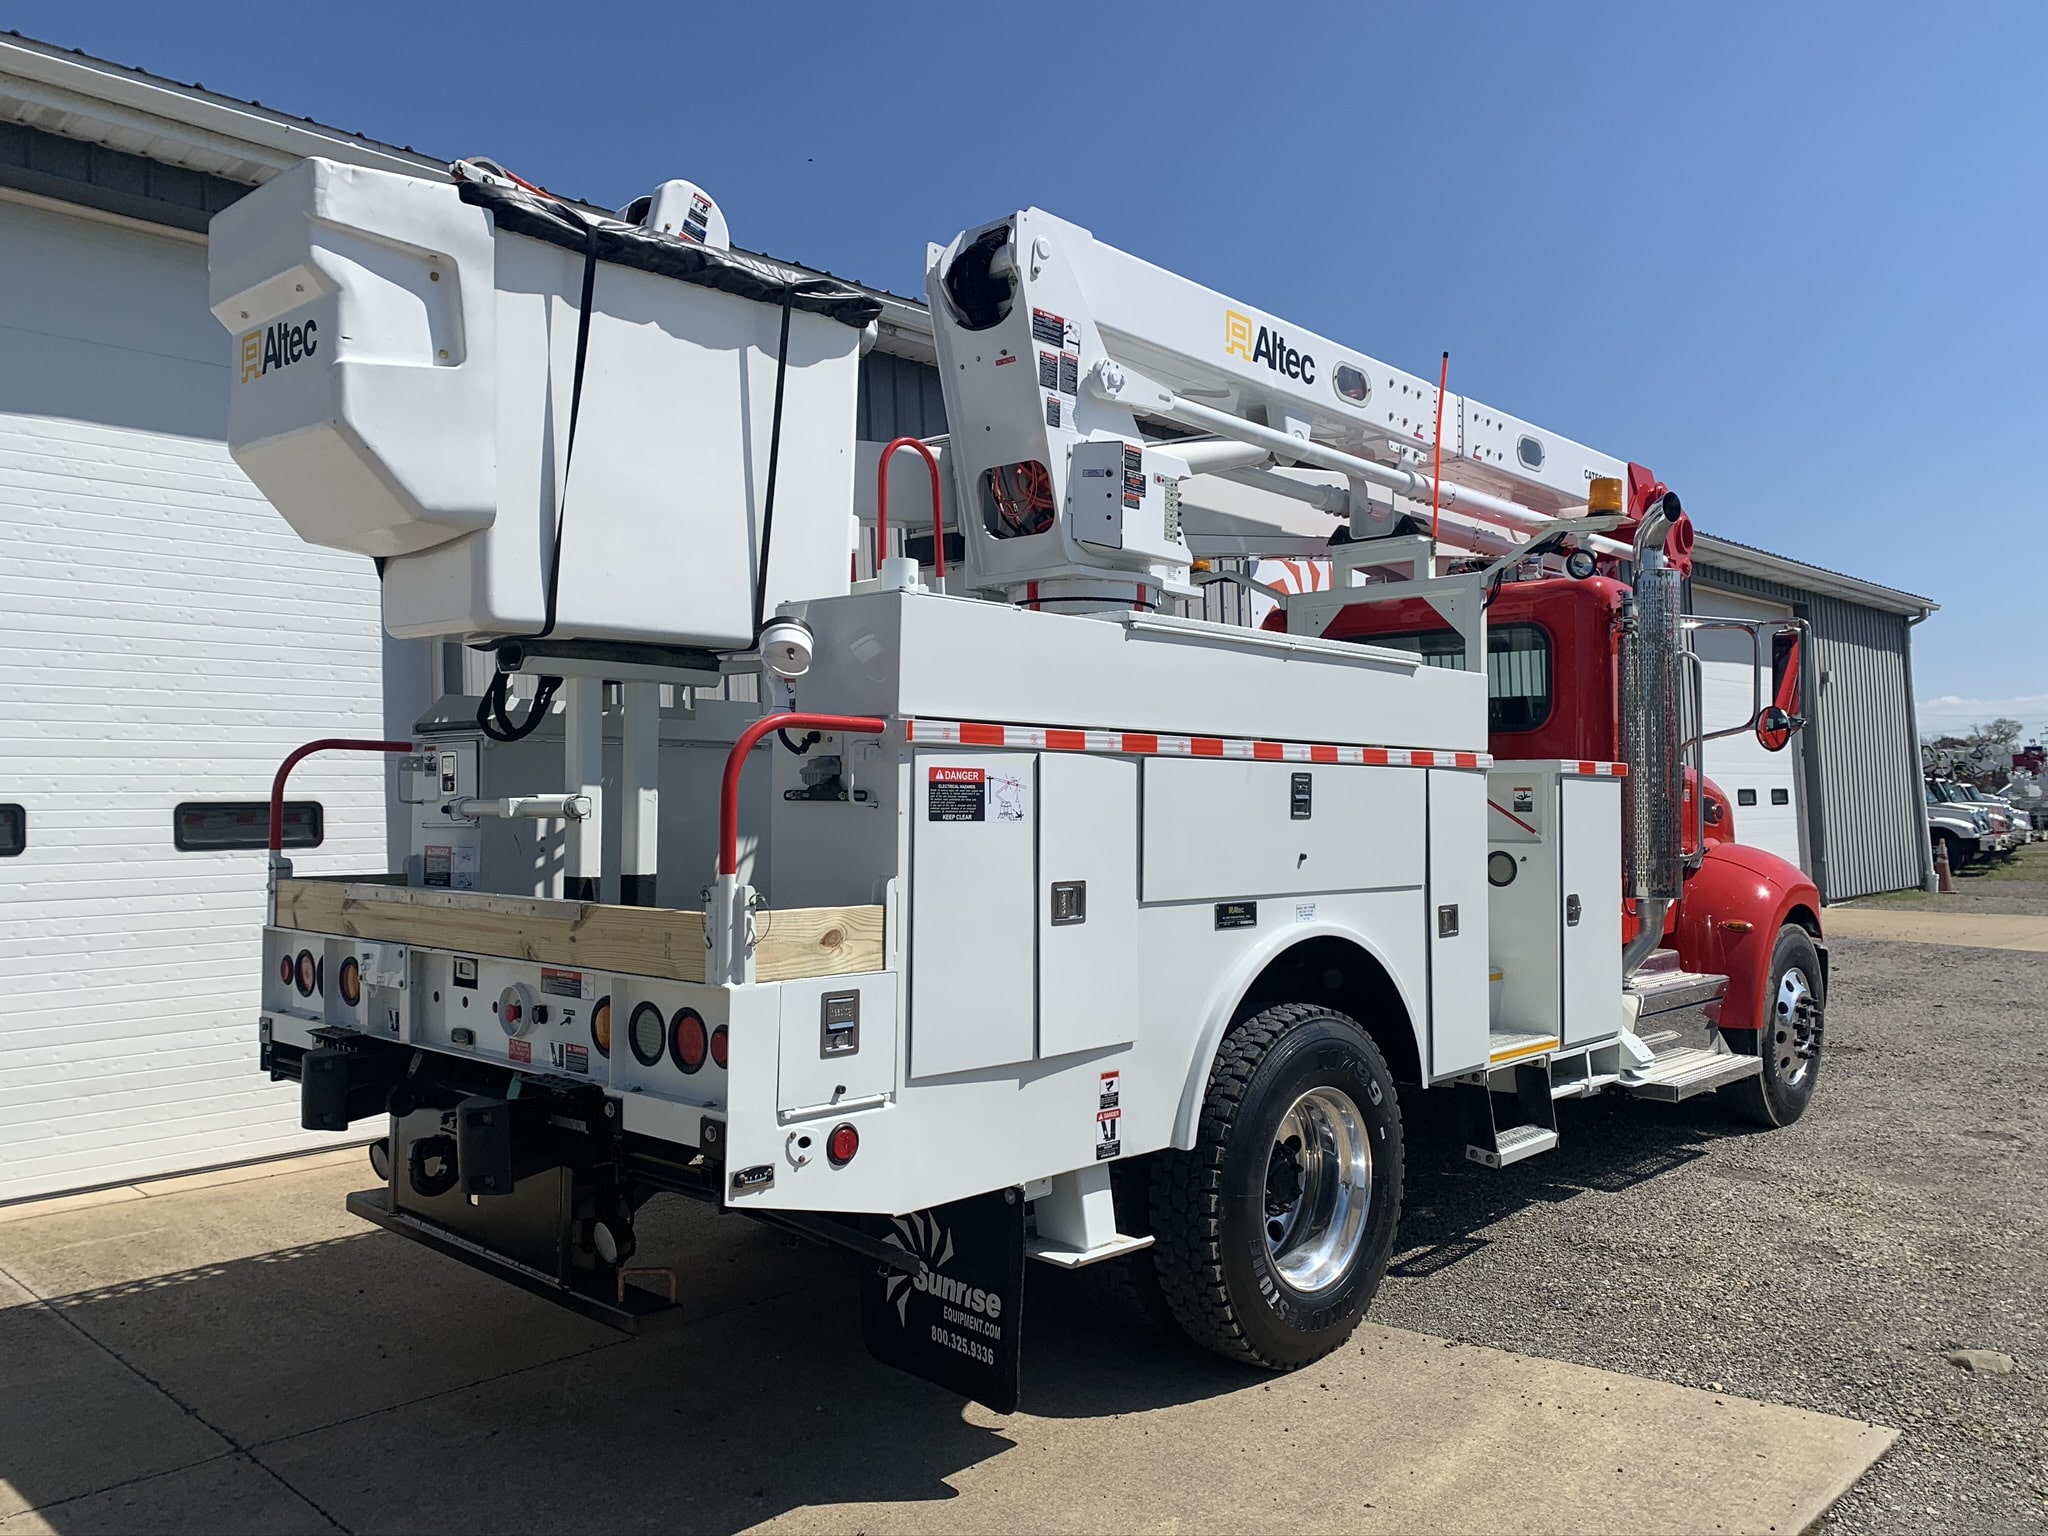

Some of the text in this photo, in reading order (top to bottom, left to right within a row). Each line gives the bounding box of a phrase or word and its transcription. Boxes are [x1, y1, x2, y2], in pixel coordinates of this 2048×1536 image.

[262, 319, 317, 375] Altec
[1252, 325, 1316, 385] Altec
[945, 770, 979, 781] DANGER
[912, 1260, 1001, 1318] Sunrise
[931, 1324, 994, 1366] 800.325.9336
[943, 1305, 1001, 1341] EQUIPMENT.COM
